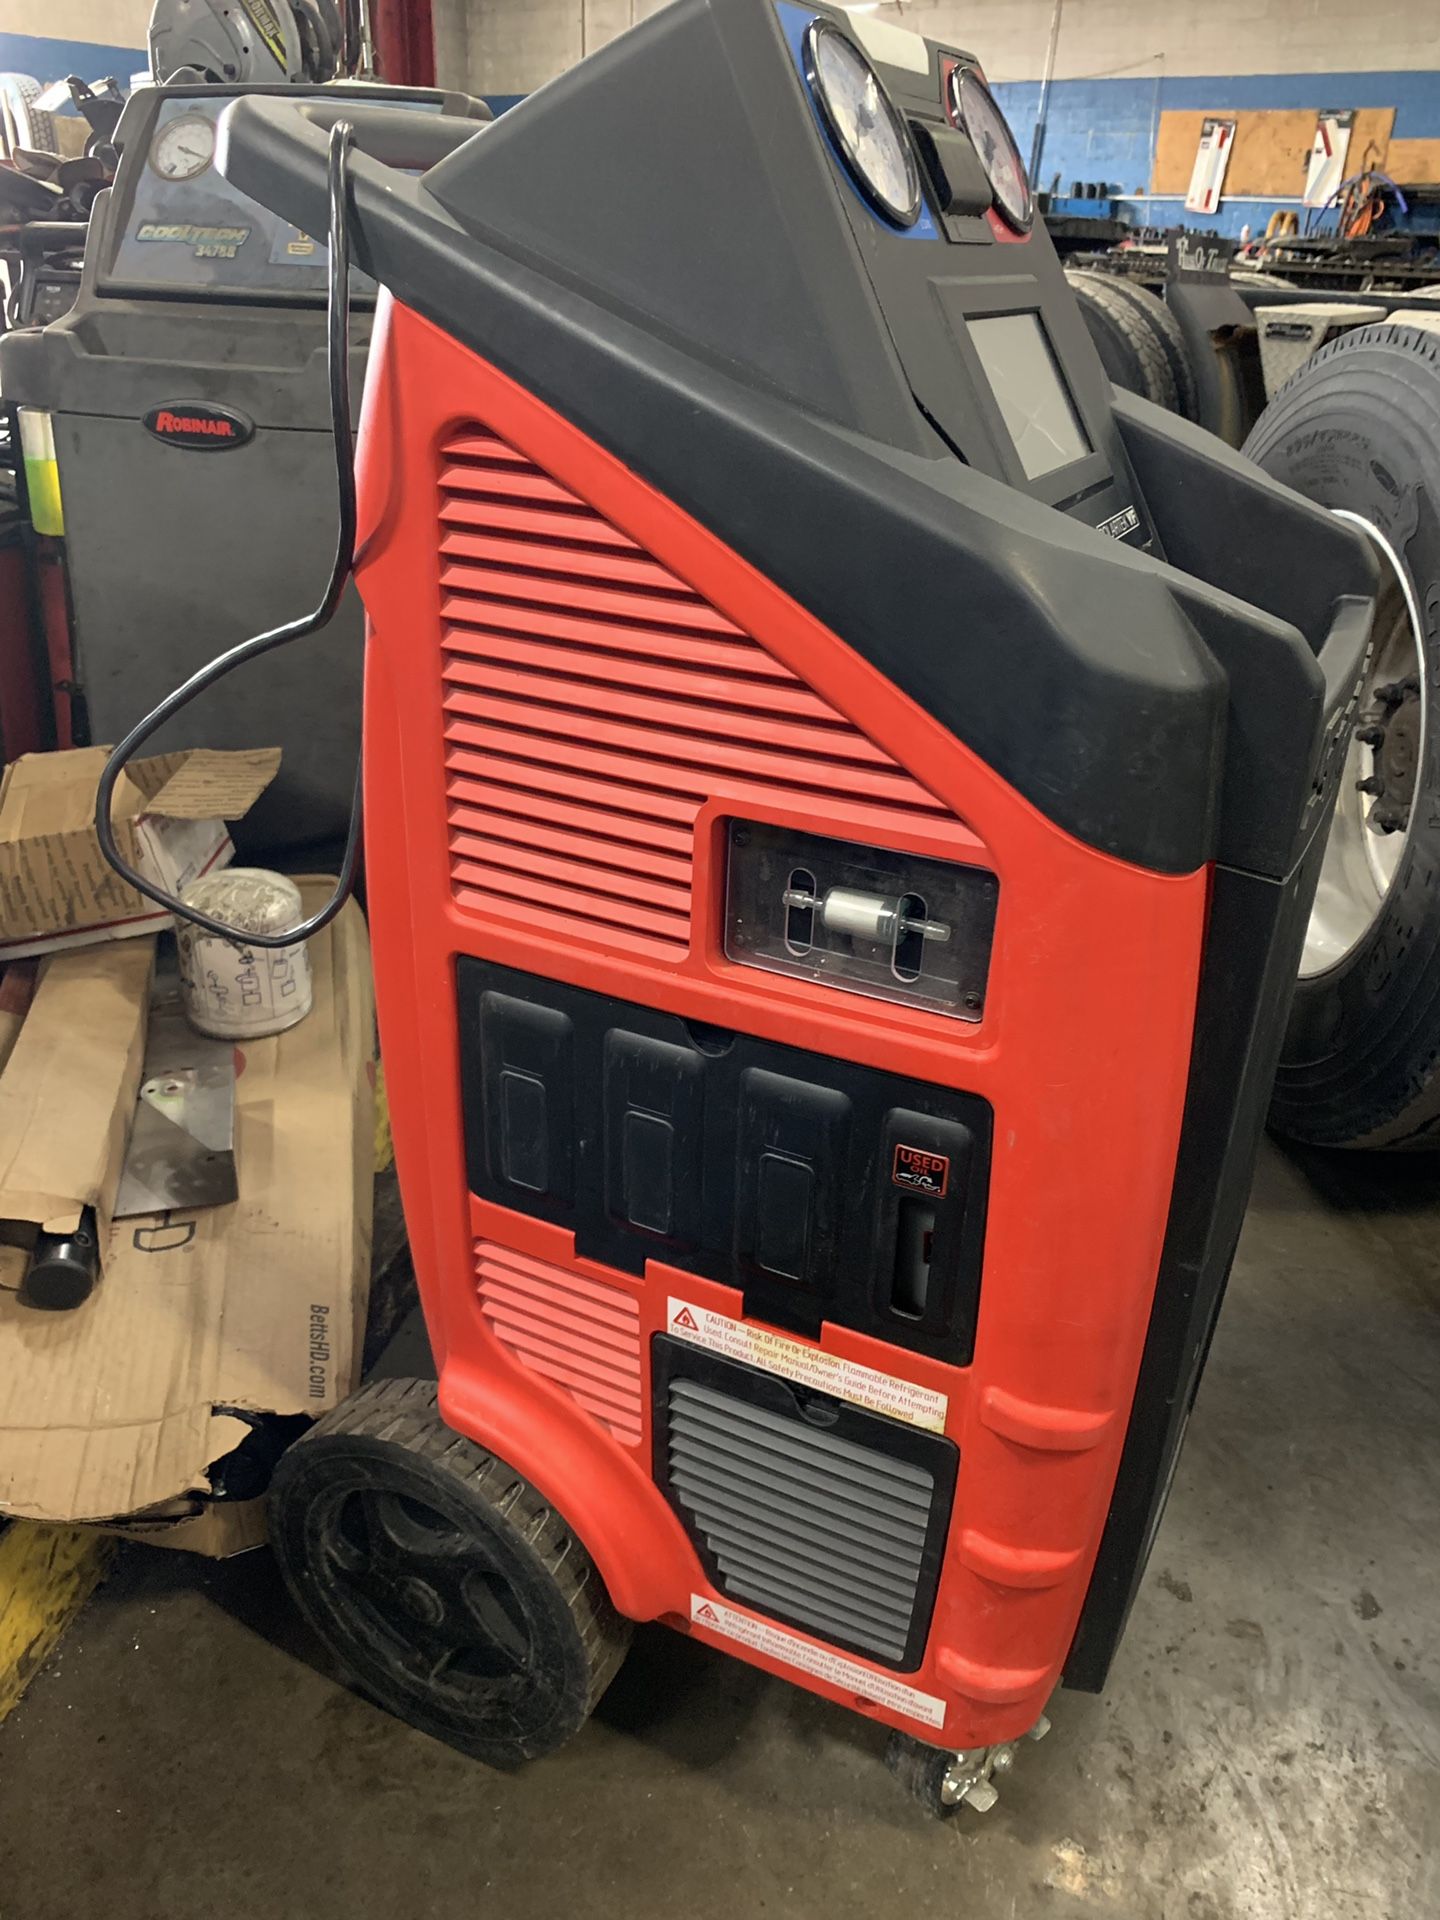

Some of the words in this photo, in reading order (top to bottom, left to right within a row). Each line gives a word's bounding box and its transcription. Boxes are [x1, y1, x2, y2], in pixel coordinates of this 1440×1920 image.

[901, 1150, 944, 1172] USED
[910, 1165, 928, 1175] OIL
[309, 1304, 330, 1398] BettsHD.com
[671, 1324, 679, 1335] To
[680, 1328, 706, 1345] Service
[708, 1338, 723, 1351] This
[757, 1356, 765, 1366] All
[769, 1360, 794, 1378] Safety
[796, 1370, 841, 1394] Precautions
[843, 1387, 862, 1402] Must
[864, 1395, 875, 1406] Be
[876, 1399, 914, 1421] Followed
[706, 1313, 737, 1332] CAUTION
[747, 1328, 761, 1341] Risk
[764, 1334, 773, 1345] Of
[775, 1339, 790, 1351] Fire
[792, 1345, 801, 1355] Or
[843, 1363, 888, 1386] Flammable
[889, 1379, 939, 1406] Refrigerant
[725, 1333, 751, 1349] Consult
[754, 1343, 777, 1360] Repair
[844, 1376, 866, 1391] Guide
[869, 1385, 896, 1402] Before
[898, 1395, 944, 1420] Attempting
